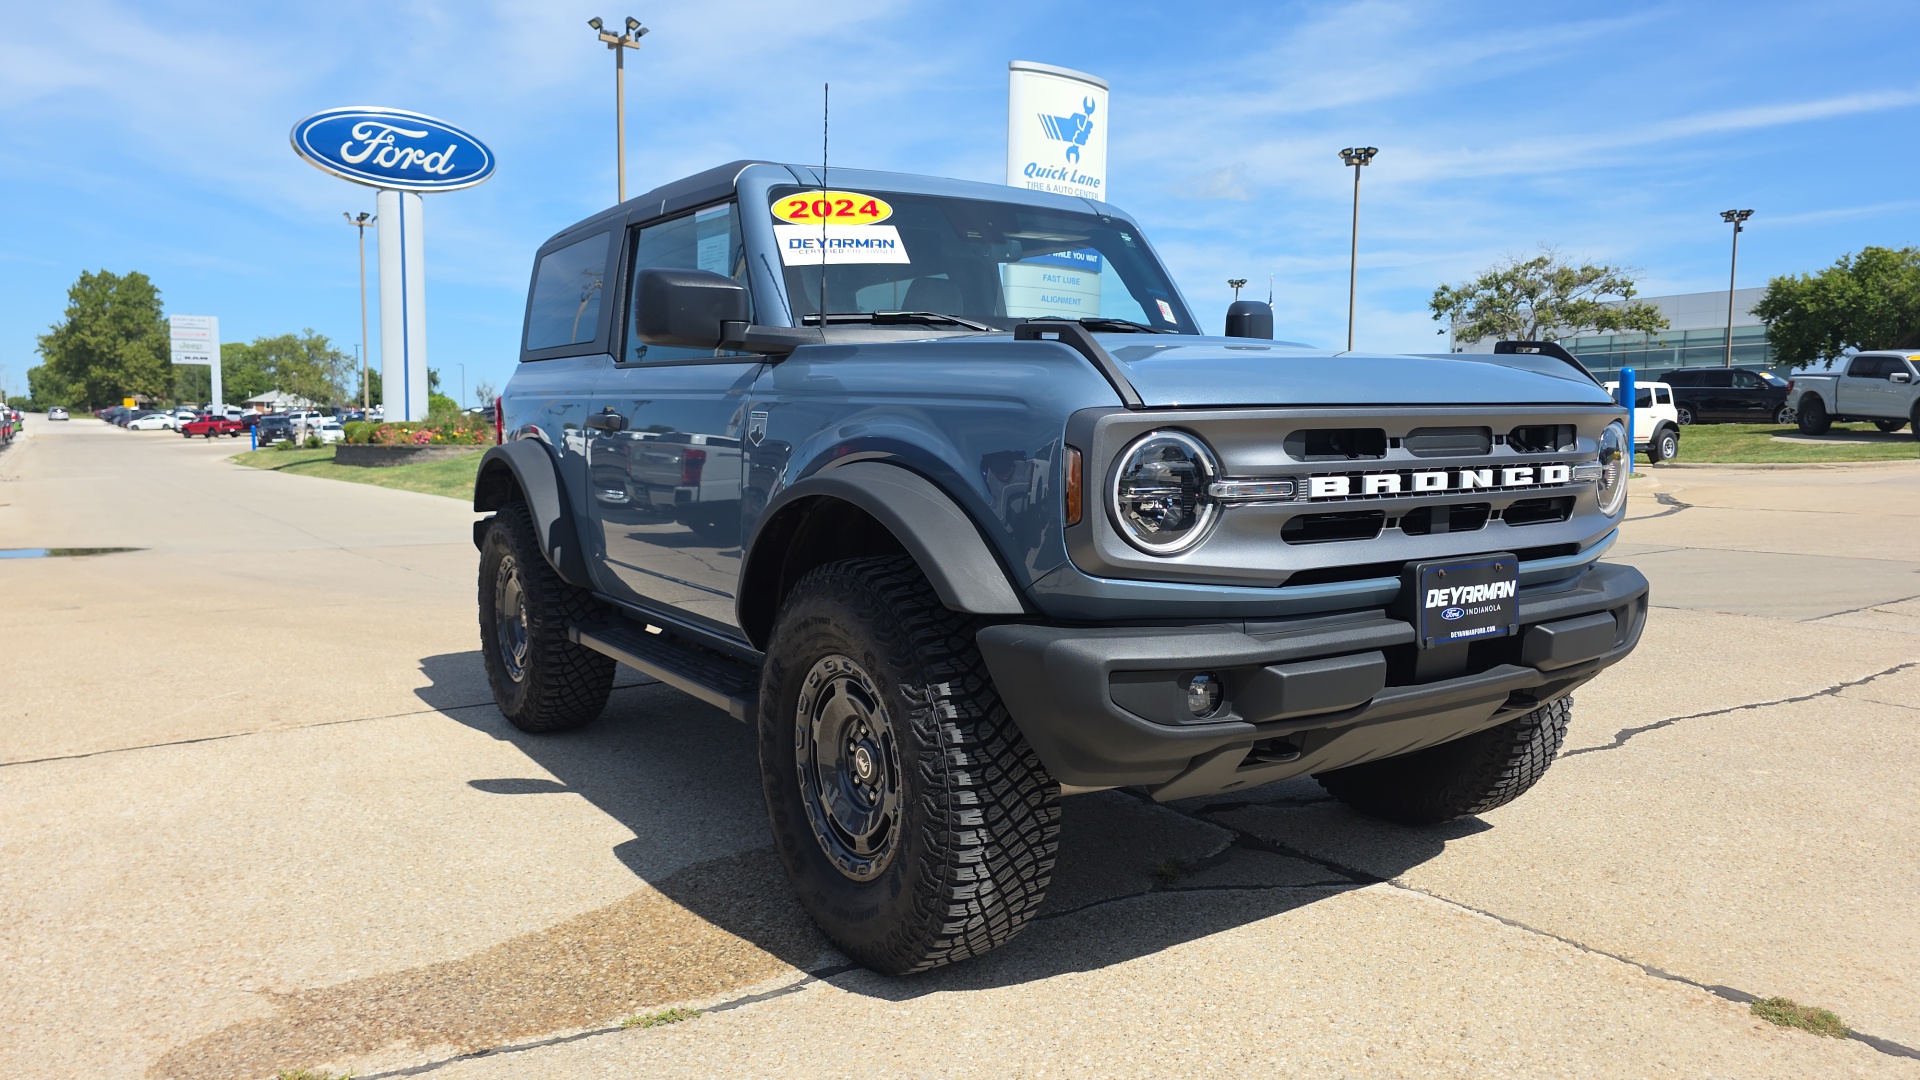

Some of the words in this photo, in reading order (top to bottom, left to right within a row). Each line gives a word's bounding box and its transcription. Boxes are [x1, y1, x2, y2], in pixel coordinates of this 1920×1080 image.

[340, 121, 458, 175] Ford
[1023, 162, 1069, 181] Quick
[1069, 169, 1101, 188] Lane
[1026, 181, 1044, 191] TIRE
[1046, 183, 1051, 191] &
[1053, 184, 1073, 195] AUTO
[1074, 188, 1099, 200] CENTER
[788, 199, 880, 219] 2024
[789, 238, 895, 249] DEYARMAN
[1072, 252, 1085, 261] YOU
[1085, 254, 1098, 263] WAIT
[1042, 273, 1061, 283] FAST
[1062, 275, 1081, 286] LUBE
[1040, 294, 1082, 306] ALIGNMENT
[1307, 464, 1570, 498] BRONCO
[1425, 580, 1517, 609] DEYARMAN
[1466, 604, 1501, 616] INDIANOLA
[1450, 625, 1496, 638] DEYARMANFORD.COM
